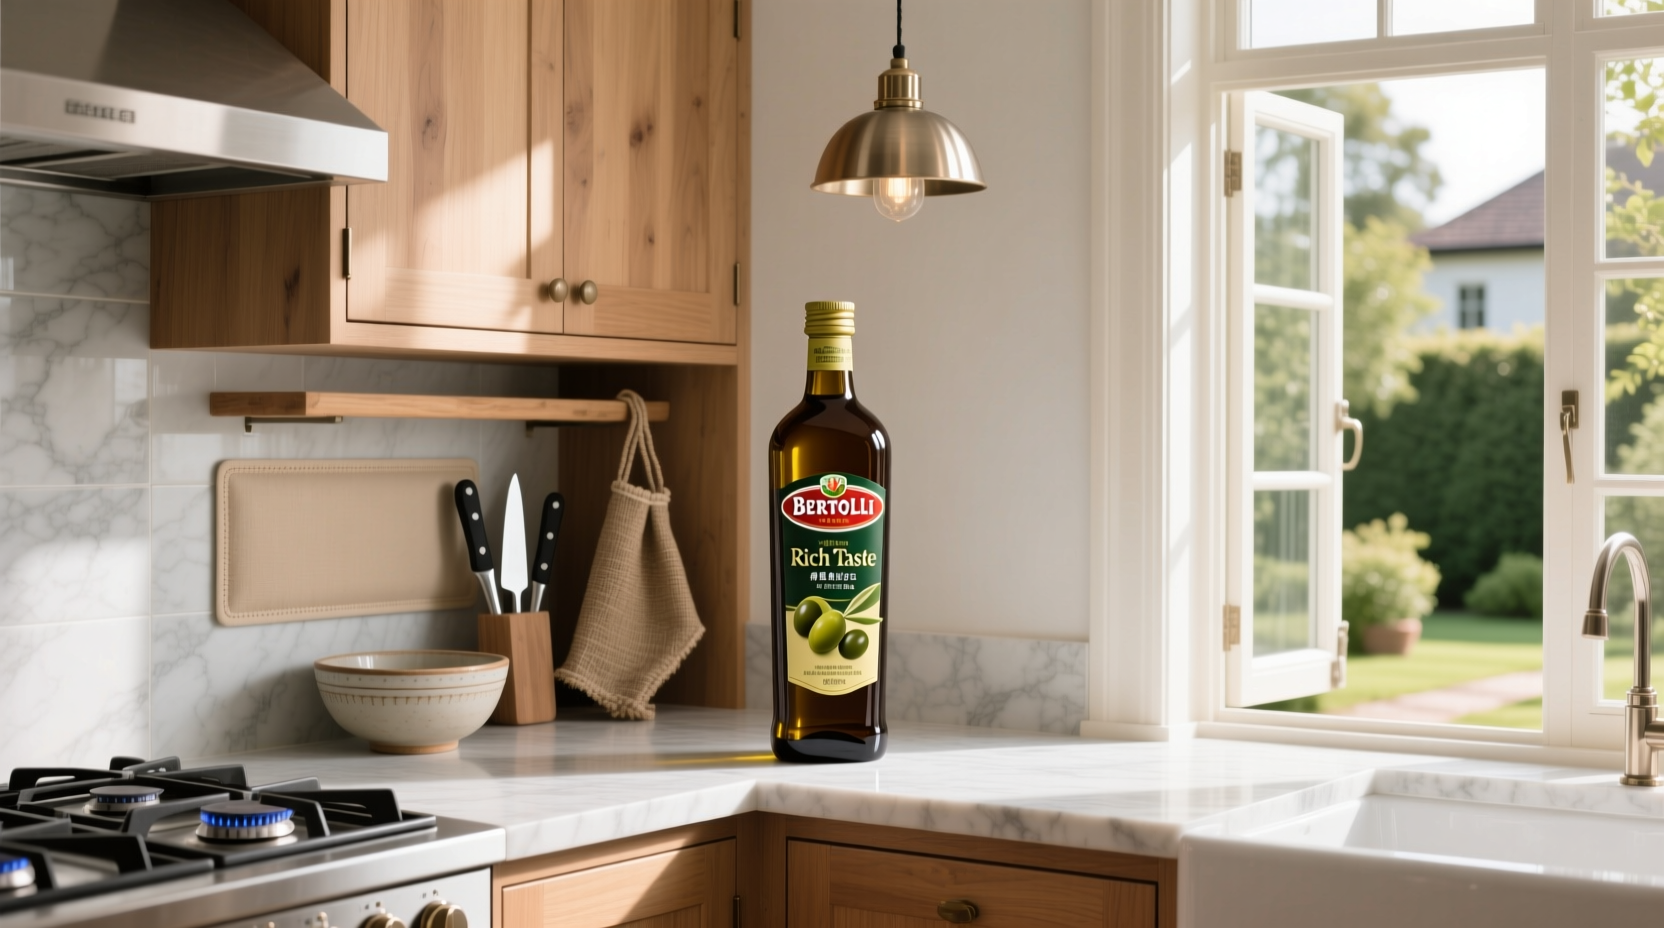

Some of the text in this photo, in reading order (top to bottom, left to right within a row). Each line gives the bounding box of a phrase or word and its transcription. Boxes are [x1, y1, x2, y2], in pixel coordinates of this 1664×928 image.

[793, 496, 874, 516] BERTOLLI
[790, 547, 877, 567] Rich Taste
